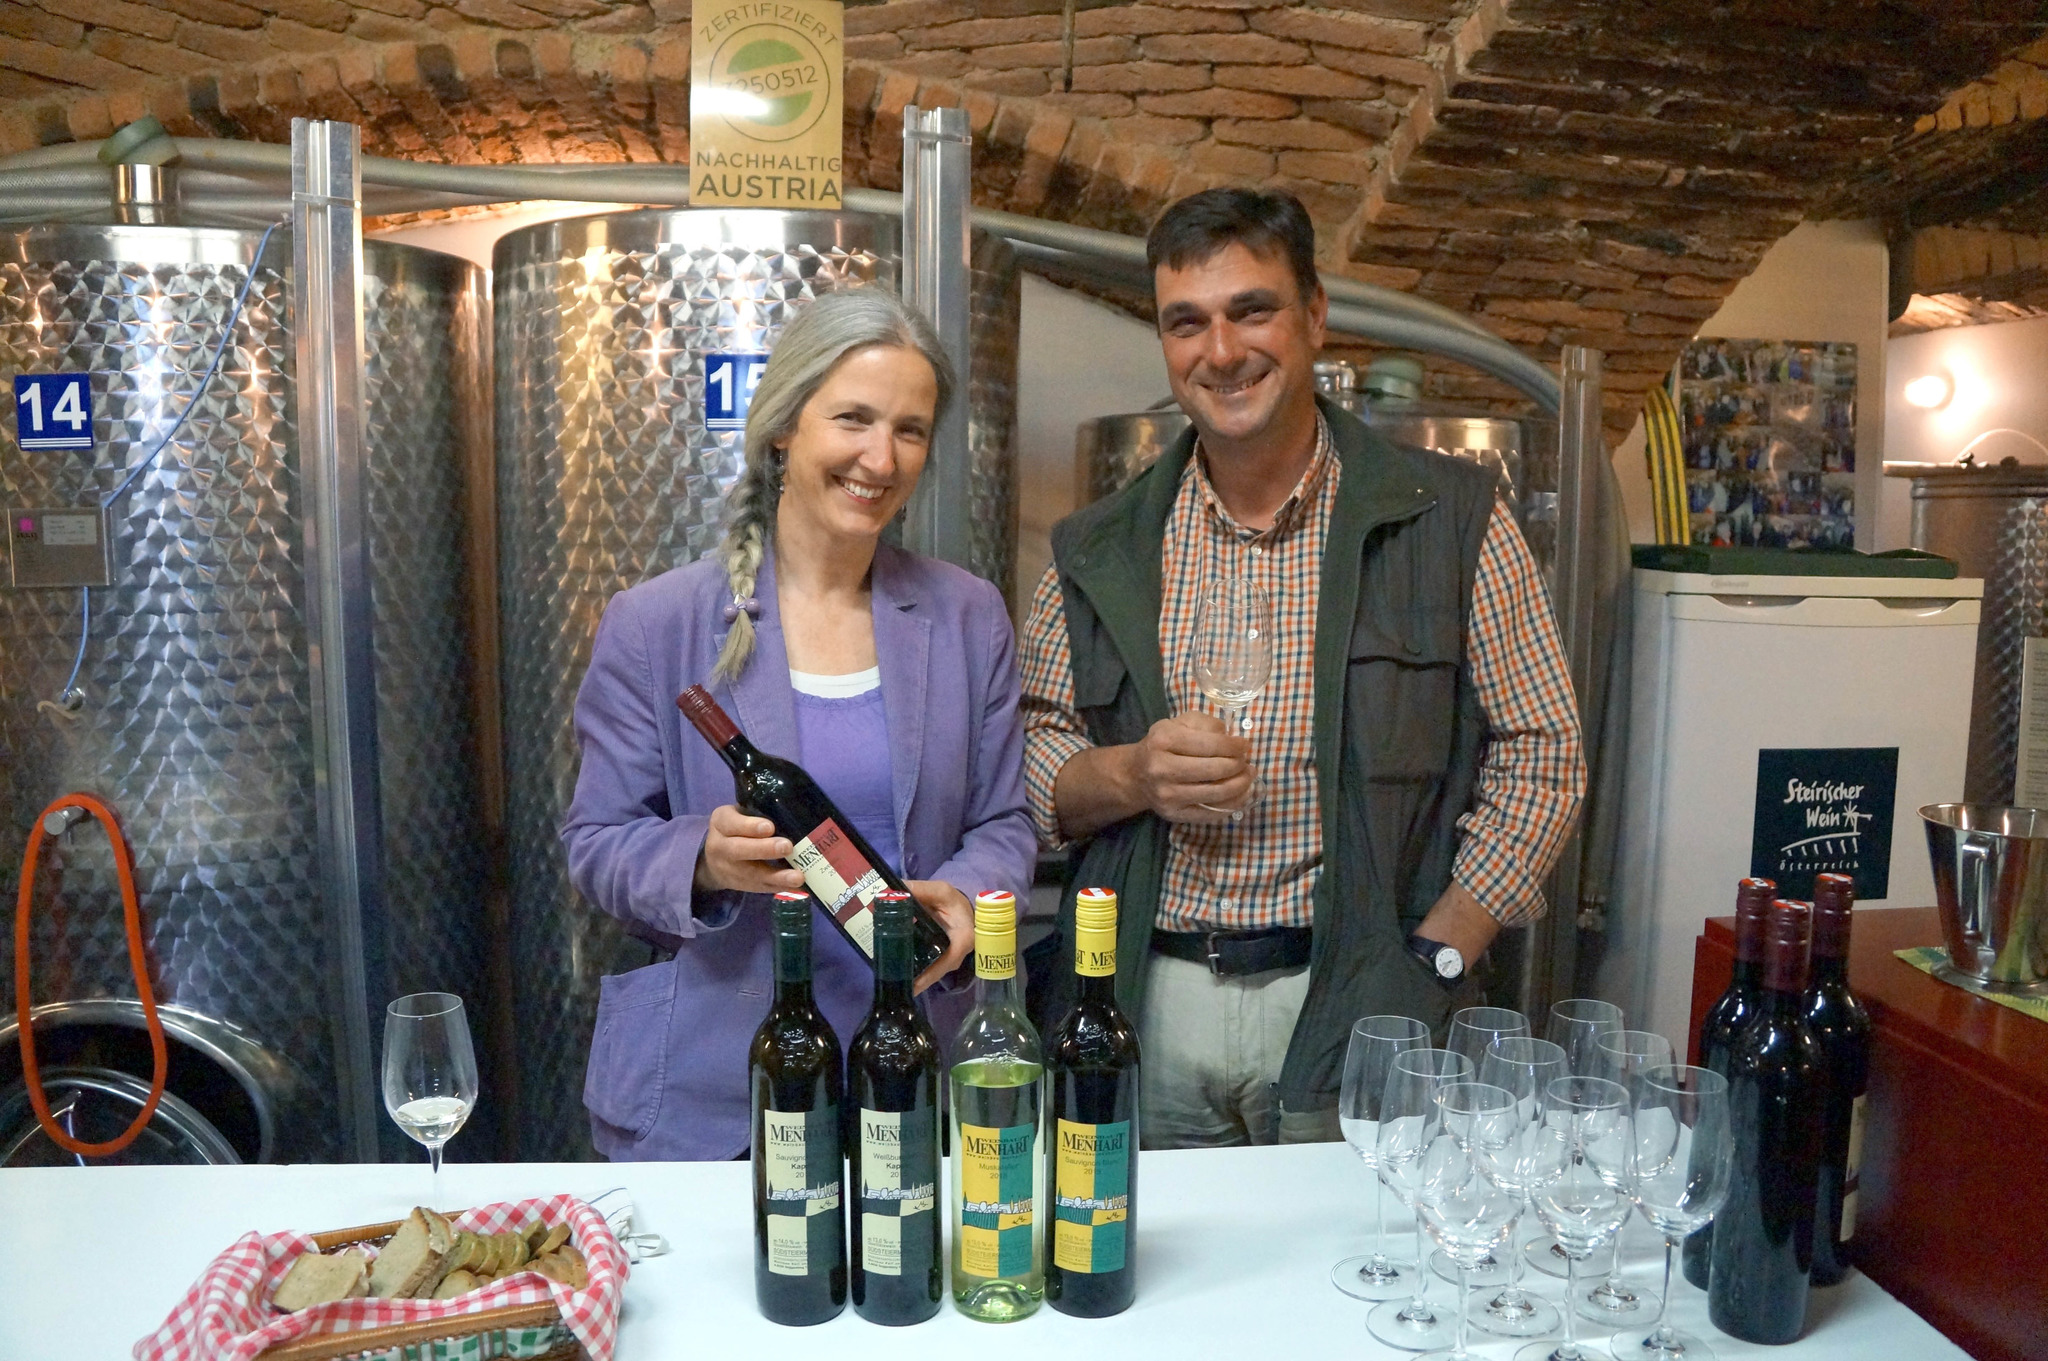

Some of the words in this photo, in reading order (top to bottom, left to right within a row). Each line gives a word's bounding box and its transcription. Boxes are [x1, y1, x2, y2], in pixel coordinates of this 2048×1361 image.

[699, 2, 838, 46] ZERTIFIZIERT
[697, 152, 841, 173] NACHHALTIG
[696, 173, 842, 202] AUSTRIA
[19, 381, 88, 432] 14
[1783, 777, 1865, 804] Steirischer
[1806, 805, 1840, 829] Wein
[966, 1134, 1030, 1156] MENHART
[1062, 1130, 1126, 1152] MENHART
